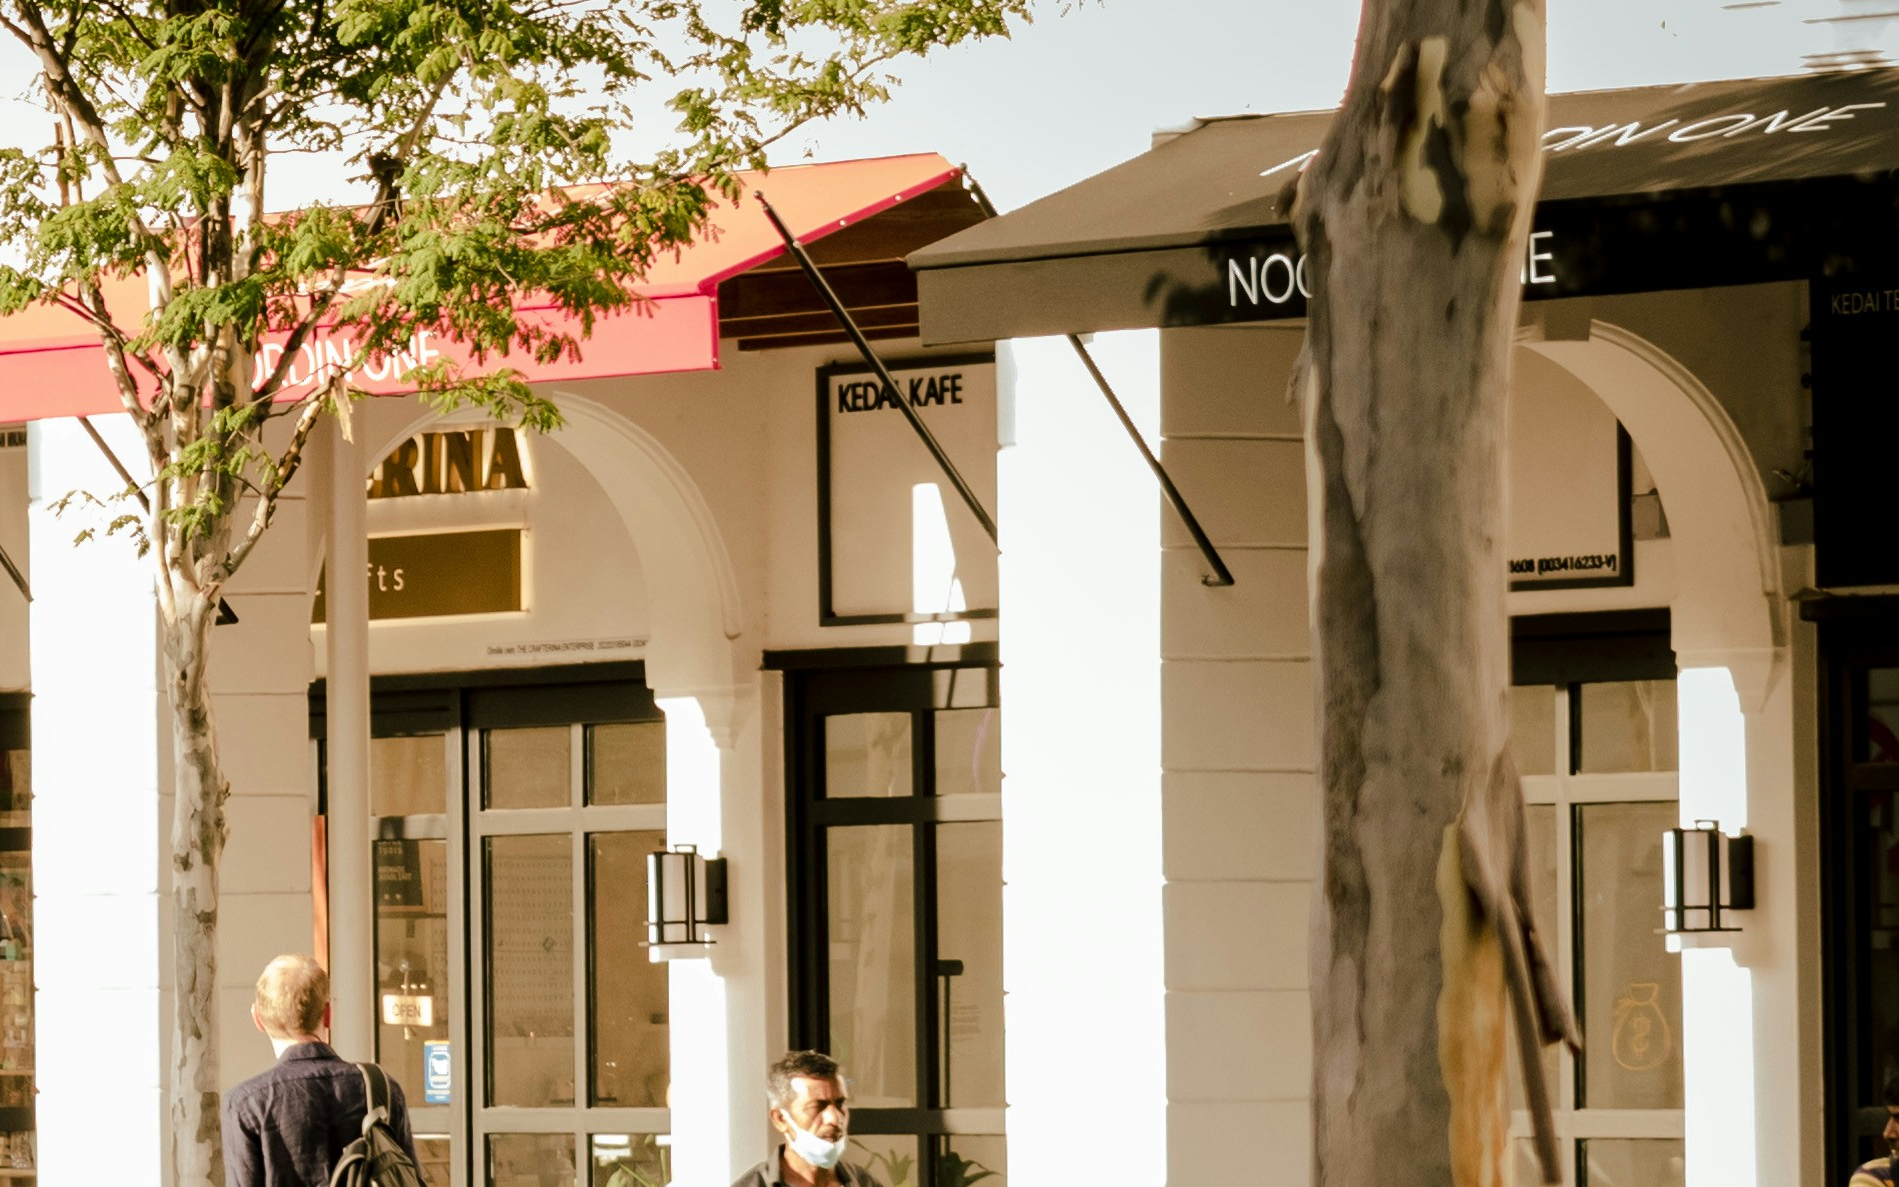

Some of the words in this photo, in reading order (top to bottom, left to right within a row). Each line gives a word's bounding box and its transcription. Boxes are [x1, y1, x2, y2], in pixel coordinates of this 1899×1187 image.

[1667, 103, 1887, 143] ONE
[1831, 292, 1880, 315] KEDAI
[909, 373, 963, 407] KAFE
